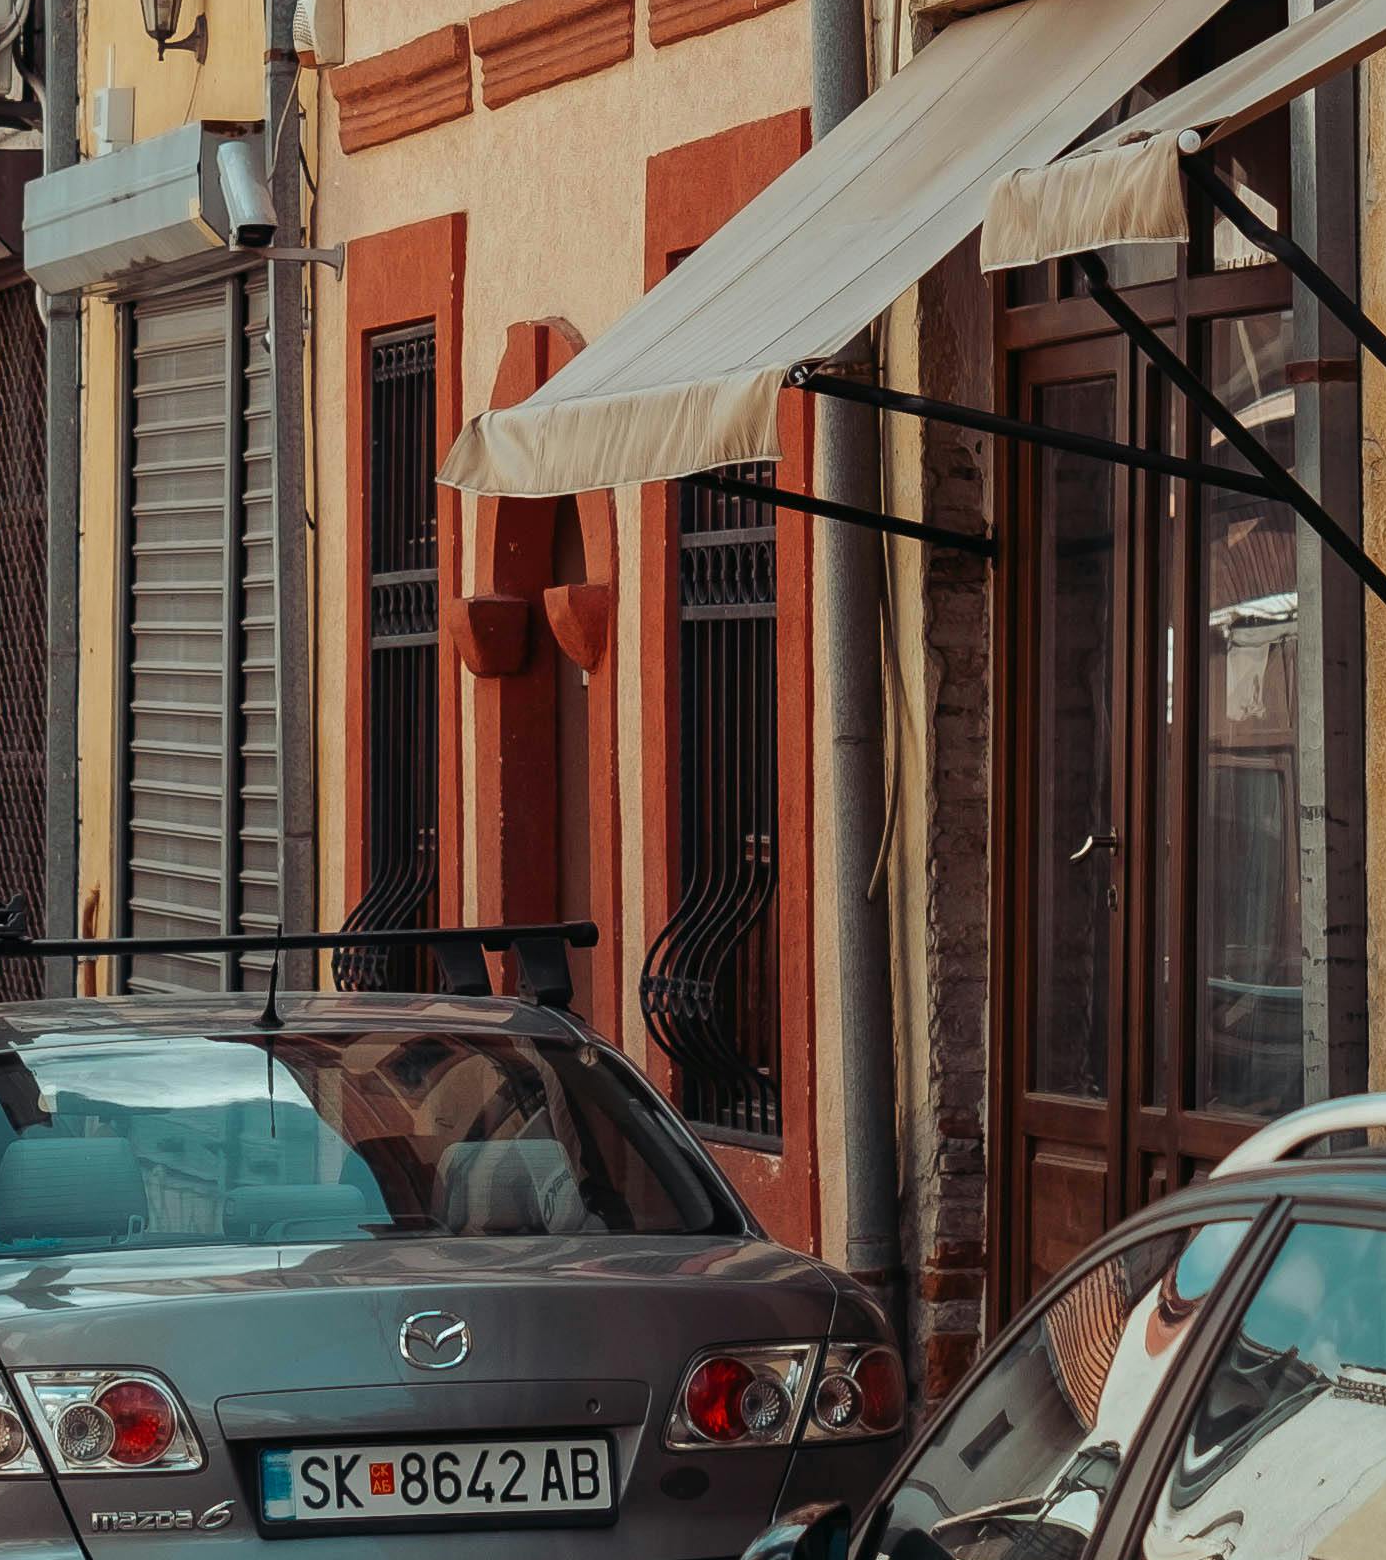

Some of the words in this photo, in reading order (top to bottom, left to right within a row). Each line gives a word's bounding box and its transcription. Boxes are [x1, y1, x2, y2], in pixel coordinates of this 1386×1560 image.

[300, 1454, 364, 1510] SK
[400, 1450, 528, 1506] 8642
[541, 1447, 600, 1502] AB
